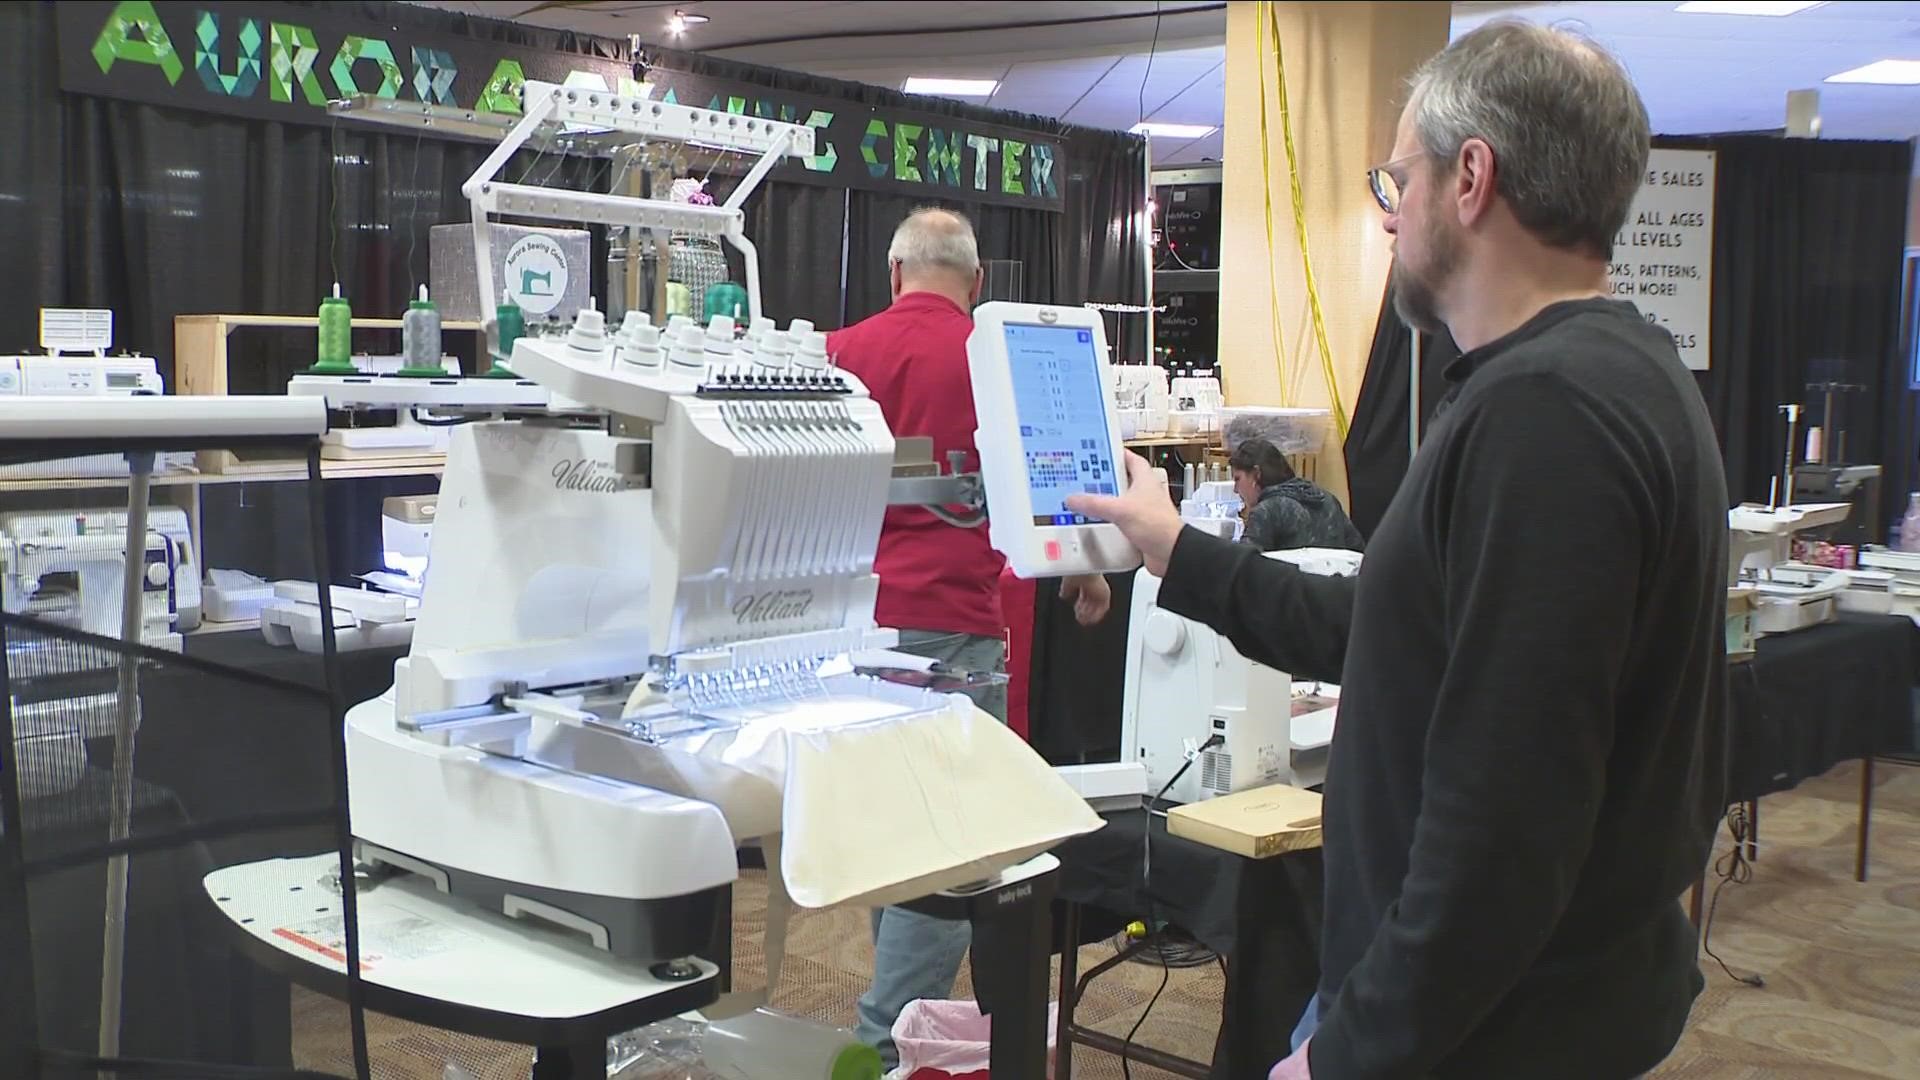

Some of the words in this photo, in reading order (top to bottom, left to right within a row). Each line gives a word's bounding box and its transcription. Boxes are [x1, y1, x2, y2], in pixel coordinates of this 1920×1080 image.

[91, 1, 526, 114] AURORA
[860, 119, 1058, 198] CENTER
[1661, 171, 1704, 187] SALES
[1637, 211, 1662, 226] ALL
[1670, 212, 1704, 227] AGES
[1633, 232, 1682, 247] LEVELS
[527, 242, 550, 254] Sewing
[550, 248, 566, 269] Center
[1640, 264, 1701, 280] PATTERNS,
[1608, 282, 1634, 296] UCH
[1640, 283, 1677, 296] MORE!
[1674, 334, 1696, 349] ELS
[551, 459, 618, 493] Valian
[732, 591, 814, 623] Valiant
